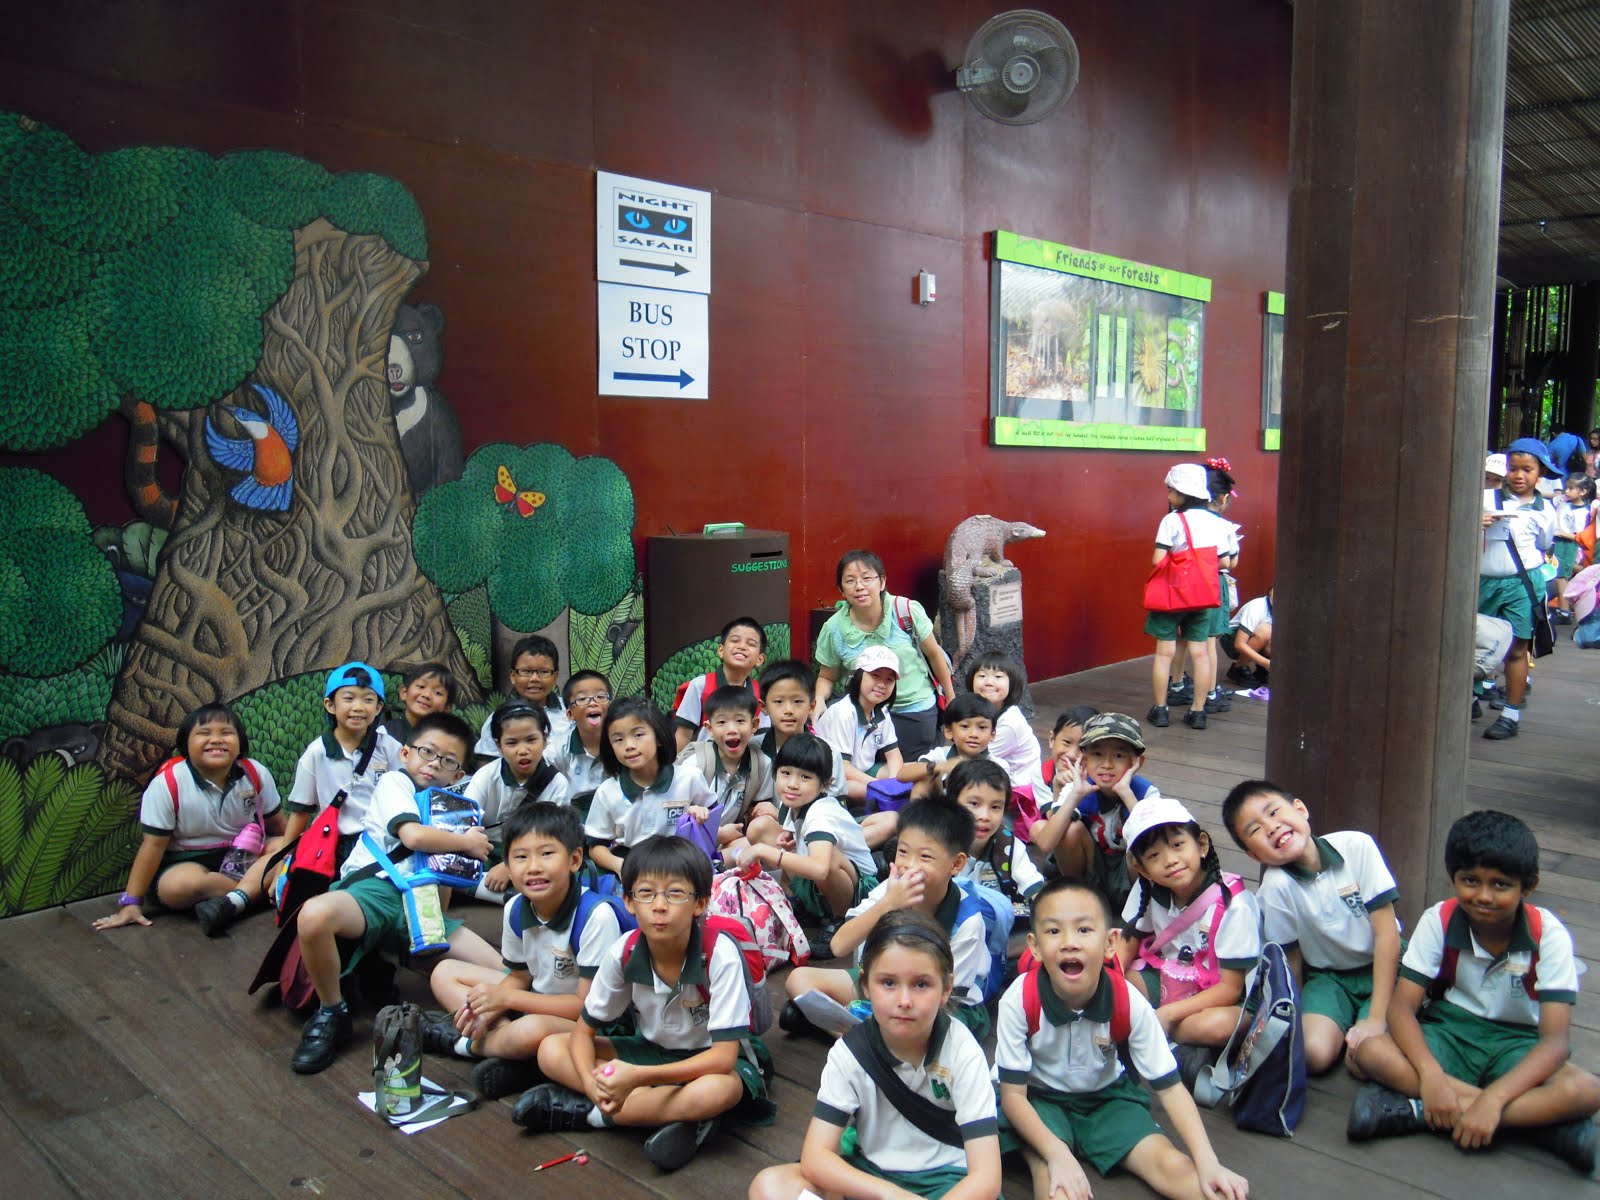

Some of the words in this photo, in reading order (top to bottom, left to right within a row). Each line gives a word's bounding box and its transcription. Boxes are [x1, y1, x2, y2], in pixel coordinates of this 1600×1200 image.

[618, 192, 693, 212] NIGHT
[617, 235, 693, 253] SAFARI
[1056, 250, 1098, 272] Friends
[1108, 265, 1121, 273] our
[1121, 266, 1160, 285] Forests
[629, 301, 673, 326] BUS
[621, 336, 682, 361] STOP
[731, 559, 788, 573] SUGGESTIONS
